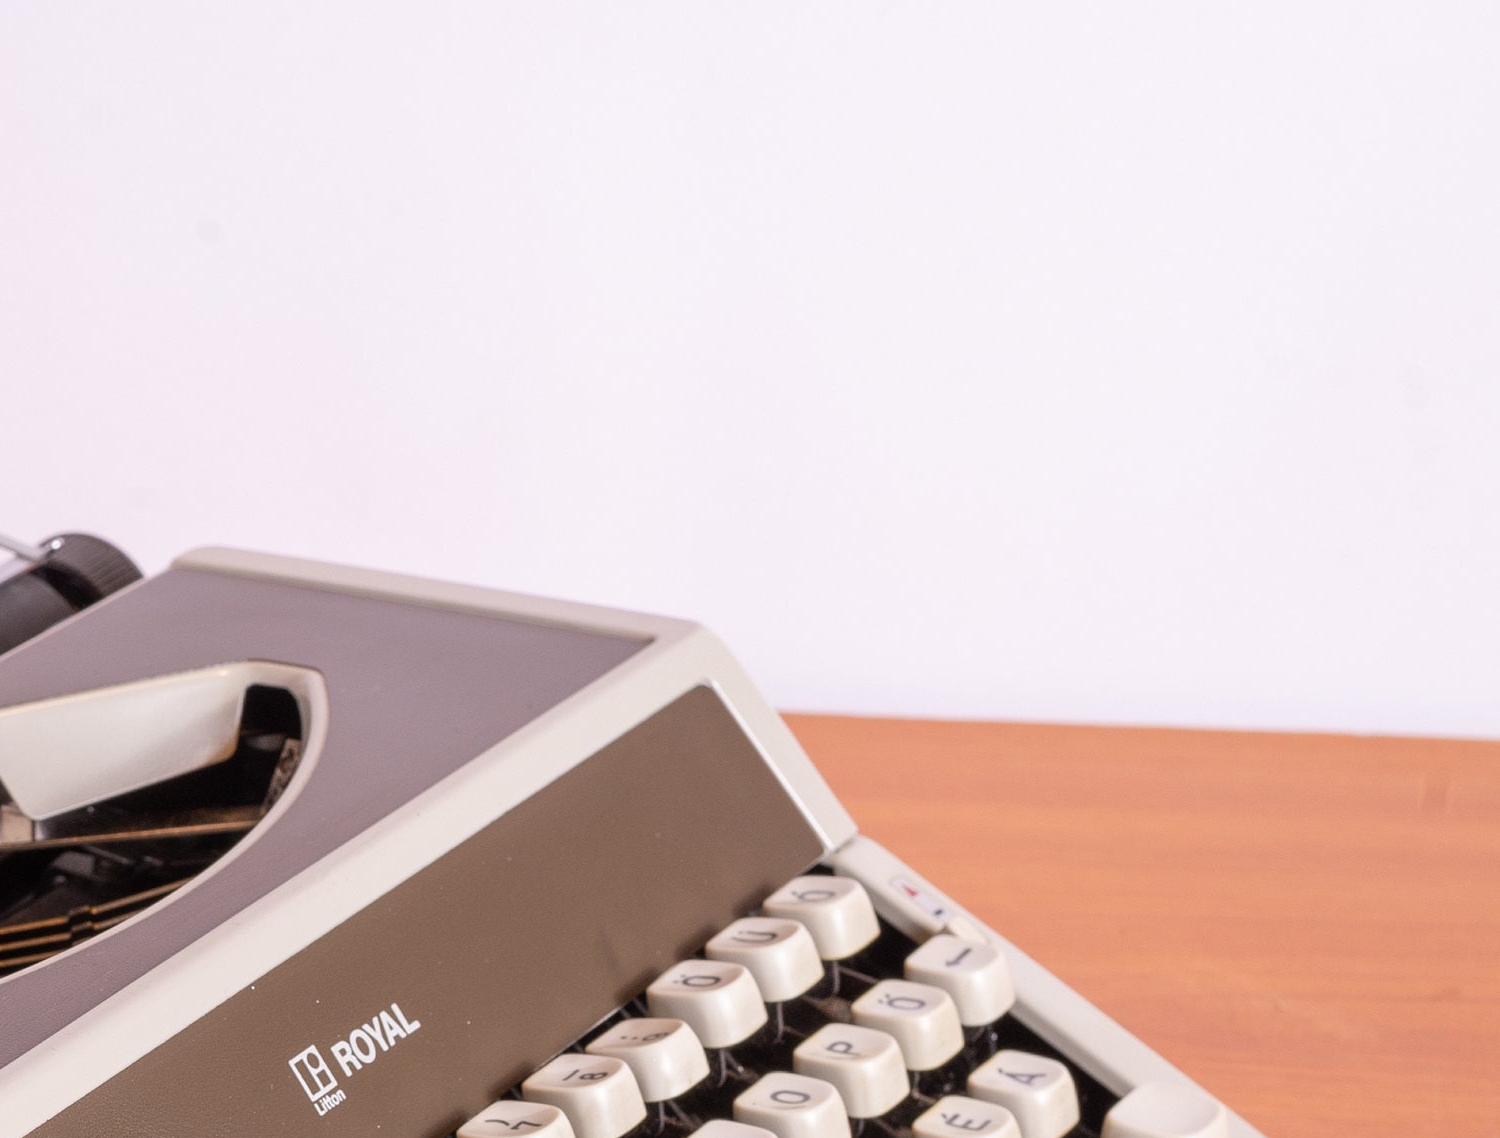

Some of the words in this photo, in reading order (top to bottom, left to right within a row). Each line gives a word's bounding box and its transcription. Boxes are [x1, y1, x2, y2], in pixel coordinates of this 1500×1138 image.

[330, 1001, 422, 1077] ROYAL
[826, 1042, 861, 1058] P
[580, 1072, 608, 1080] 8
[998, 1068, 1046, 1084] Á
[313, 1089, 347, 1117] Litton
[770, 1090, 810, 1104] O
[510, 1121, 542, 1130] 7
[942, 1114, 991, 1131] É
